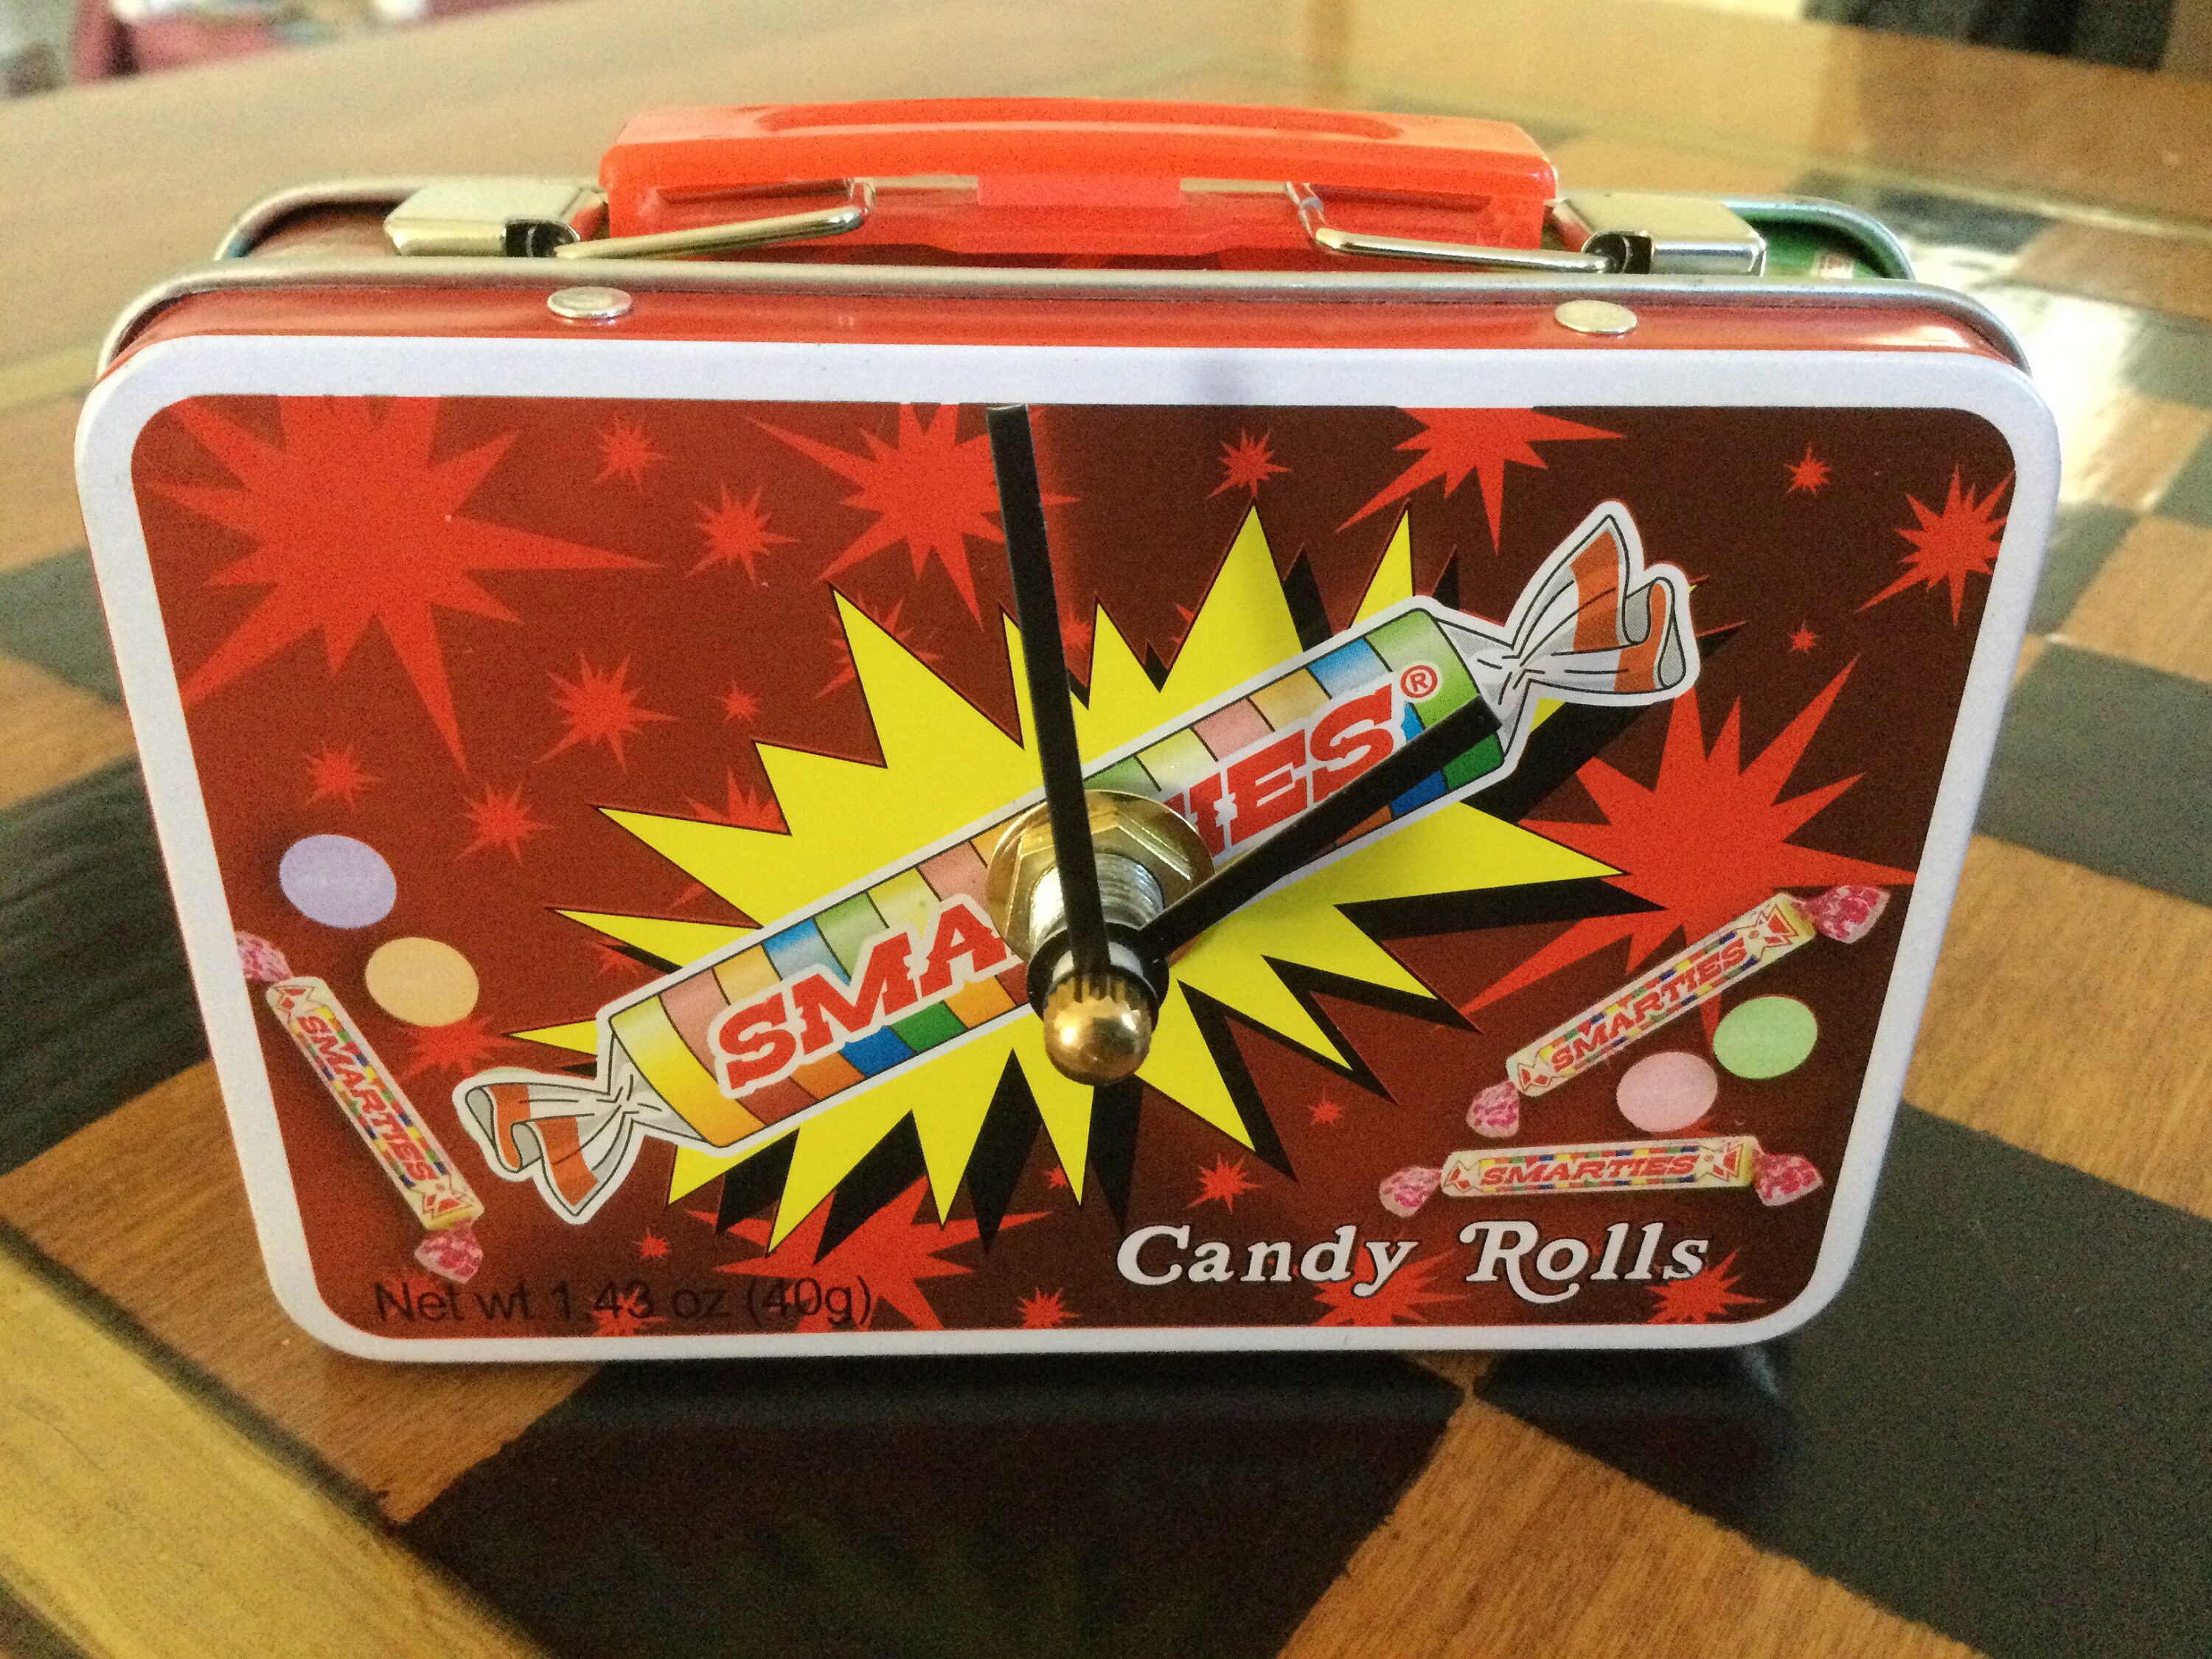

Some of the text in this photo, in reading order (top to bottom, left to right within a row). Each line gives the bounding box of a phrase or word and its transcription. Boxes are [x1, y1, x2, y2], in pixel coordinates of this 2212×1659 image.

[719, 684, 1394, 1090] SMAIES
[1551, 938, 1747, 1068] SMARTIES
[295, 1016, 439, 1180] SMARTIES
[1481, 1156, 1698, 1183] SMARTIES
[374, 1281, 465, 1322] Net
[473, 1281, 535, 1321] wt
[672, 1290, 731, 1319] oz
[746, 1275, 872, 1326] (40g)
[1116, 1221, 1710, 1304] Candy Rolls
